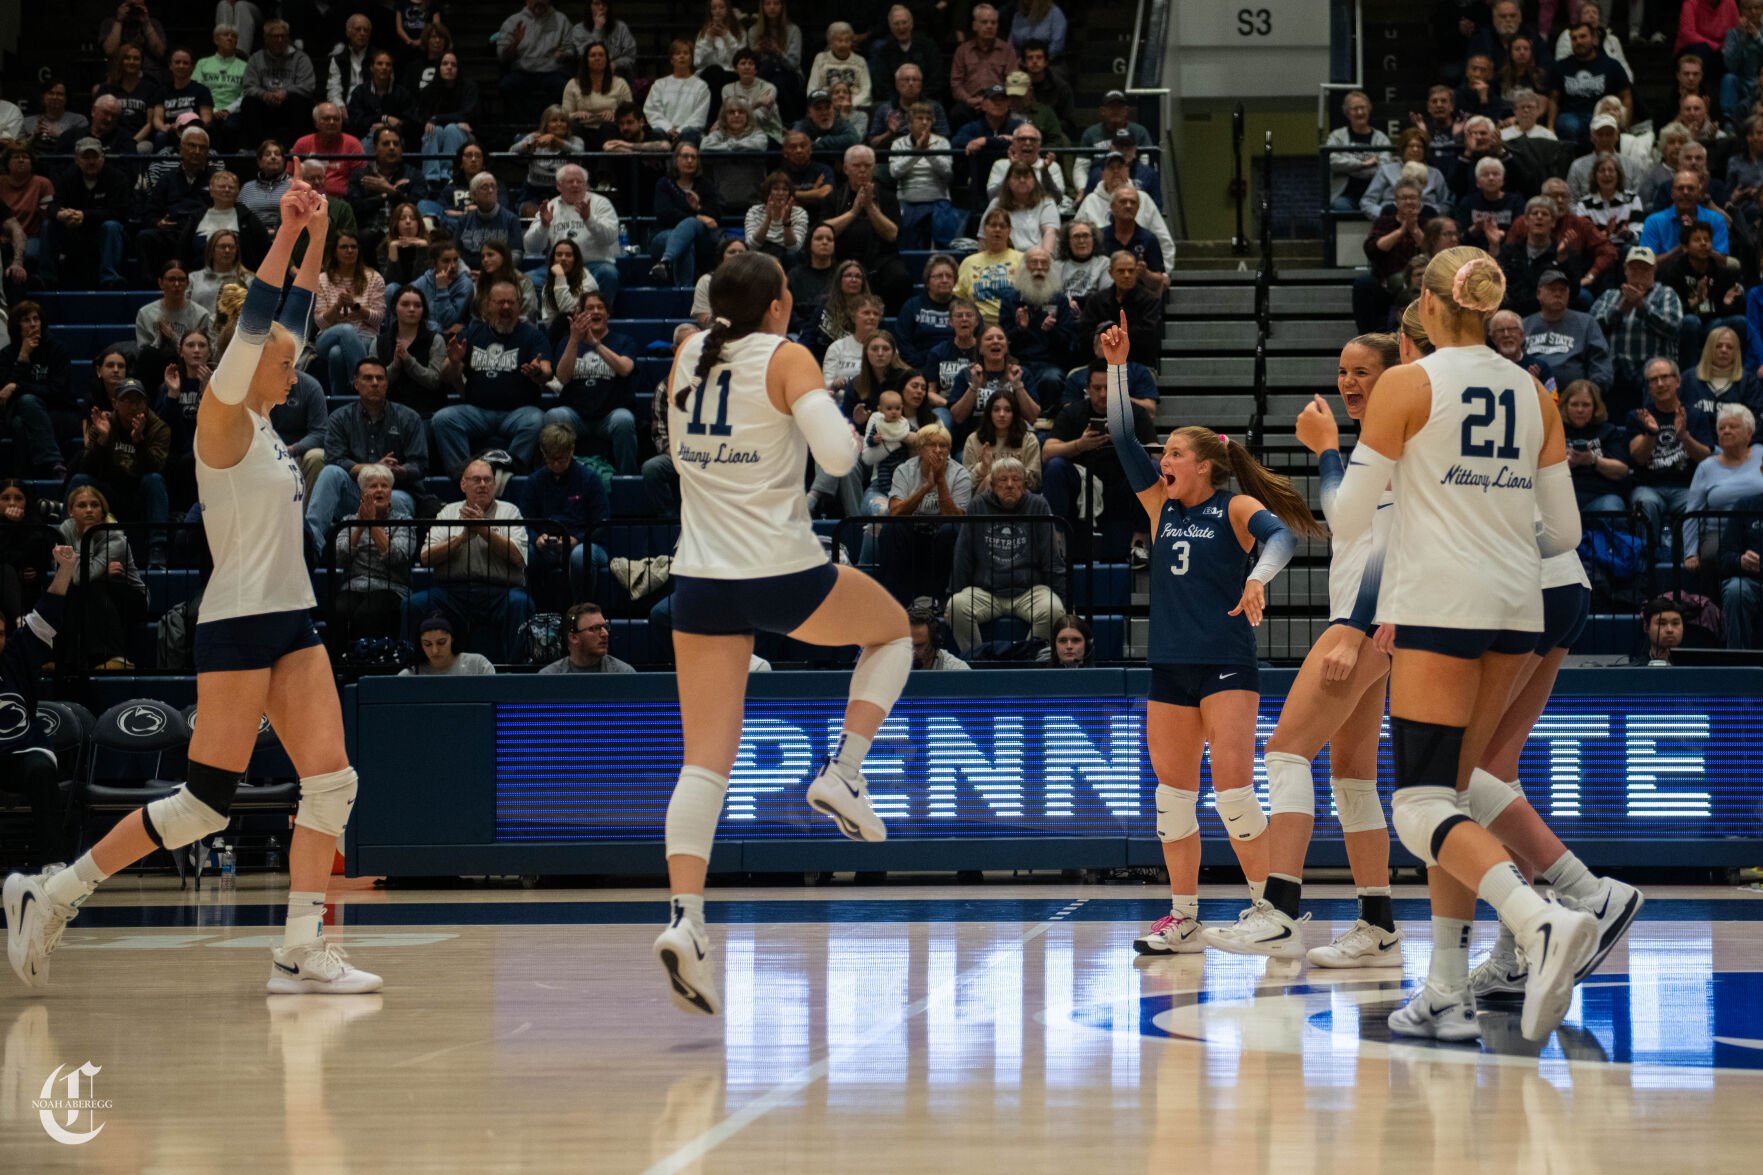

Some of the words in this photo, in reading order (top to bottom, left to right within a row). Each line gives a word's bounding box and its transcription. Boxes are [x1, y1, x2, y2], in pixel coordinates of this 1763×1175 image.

[1238, 9, 1271, 36] S3
[1112, 57, 1127, 75] G
[1384, 55, 1398, 72] G
[38, 66, 52, 82] G
[1384, 87, 1398, 104] F
[1387, 120, 1401, 138] E
[1549, 331, 1575, 349] STATE
[687, 370, 732, 436] 11
[1461, 386, 1520, 460] 21
[713, 443, 761, 464] Lions
[1440, 464, 1490, 493] Nittany
[1491, 465, 1533, 490] Lions
[1160, 522, 1182, 539] Penn
[1183, 523, 1216, 539] State
[1170, 540, 1191, 576] 3
[727, 715, 1141, 819] PENN
